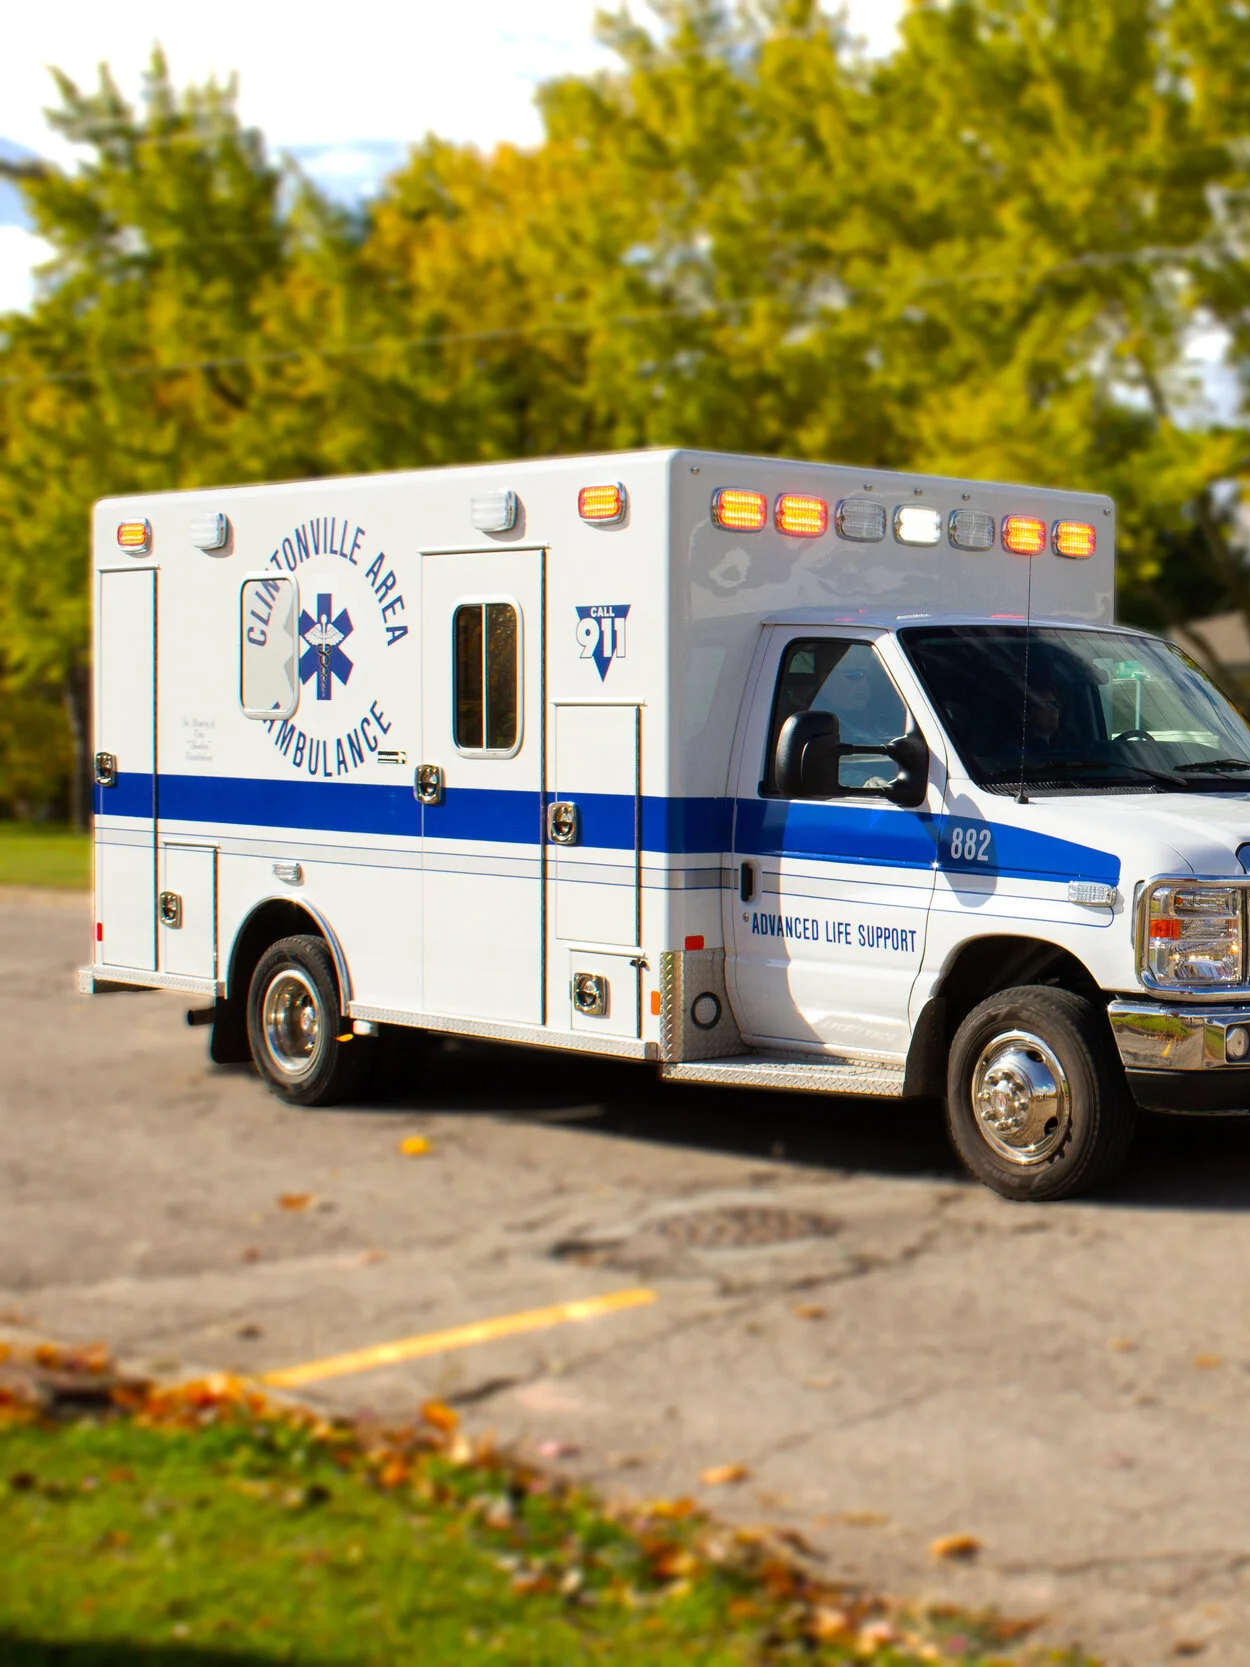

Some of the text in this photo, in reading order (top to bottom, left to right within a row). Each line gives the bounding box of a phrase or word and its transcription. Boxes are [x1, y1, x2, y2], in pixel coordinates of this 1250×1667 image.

[365, 552, 409, 647] AREA
[590, 606, 616, 618] CALL
[576, 617, 626, 659] 911
[951, 827, 992, 861] 882
[752, 912, 917, 953] ADVANCED LIFE SUPPORT
